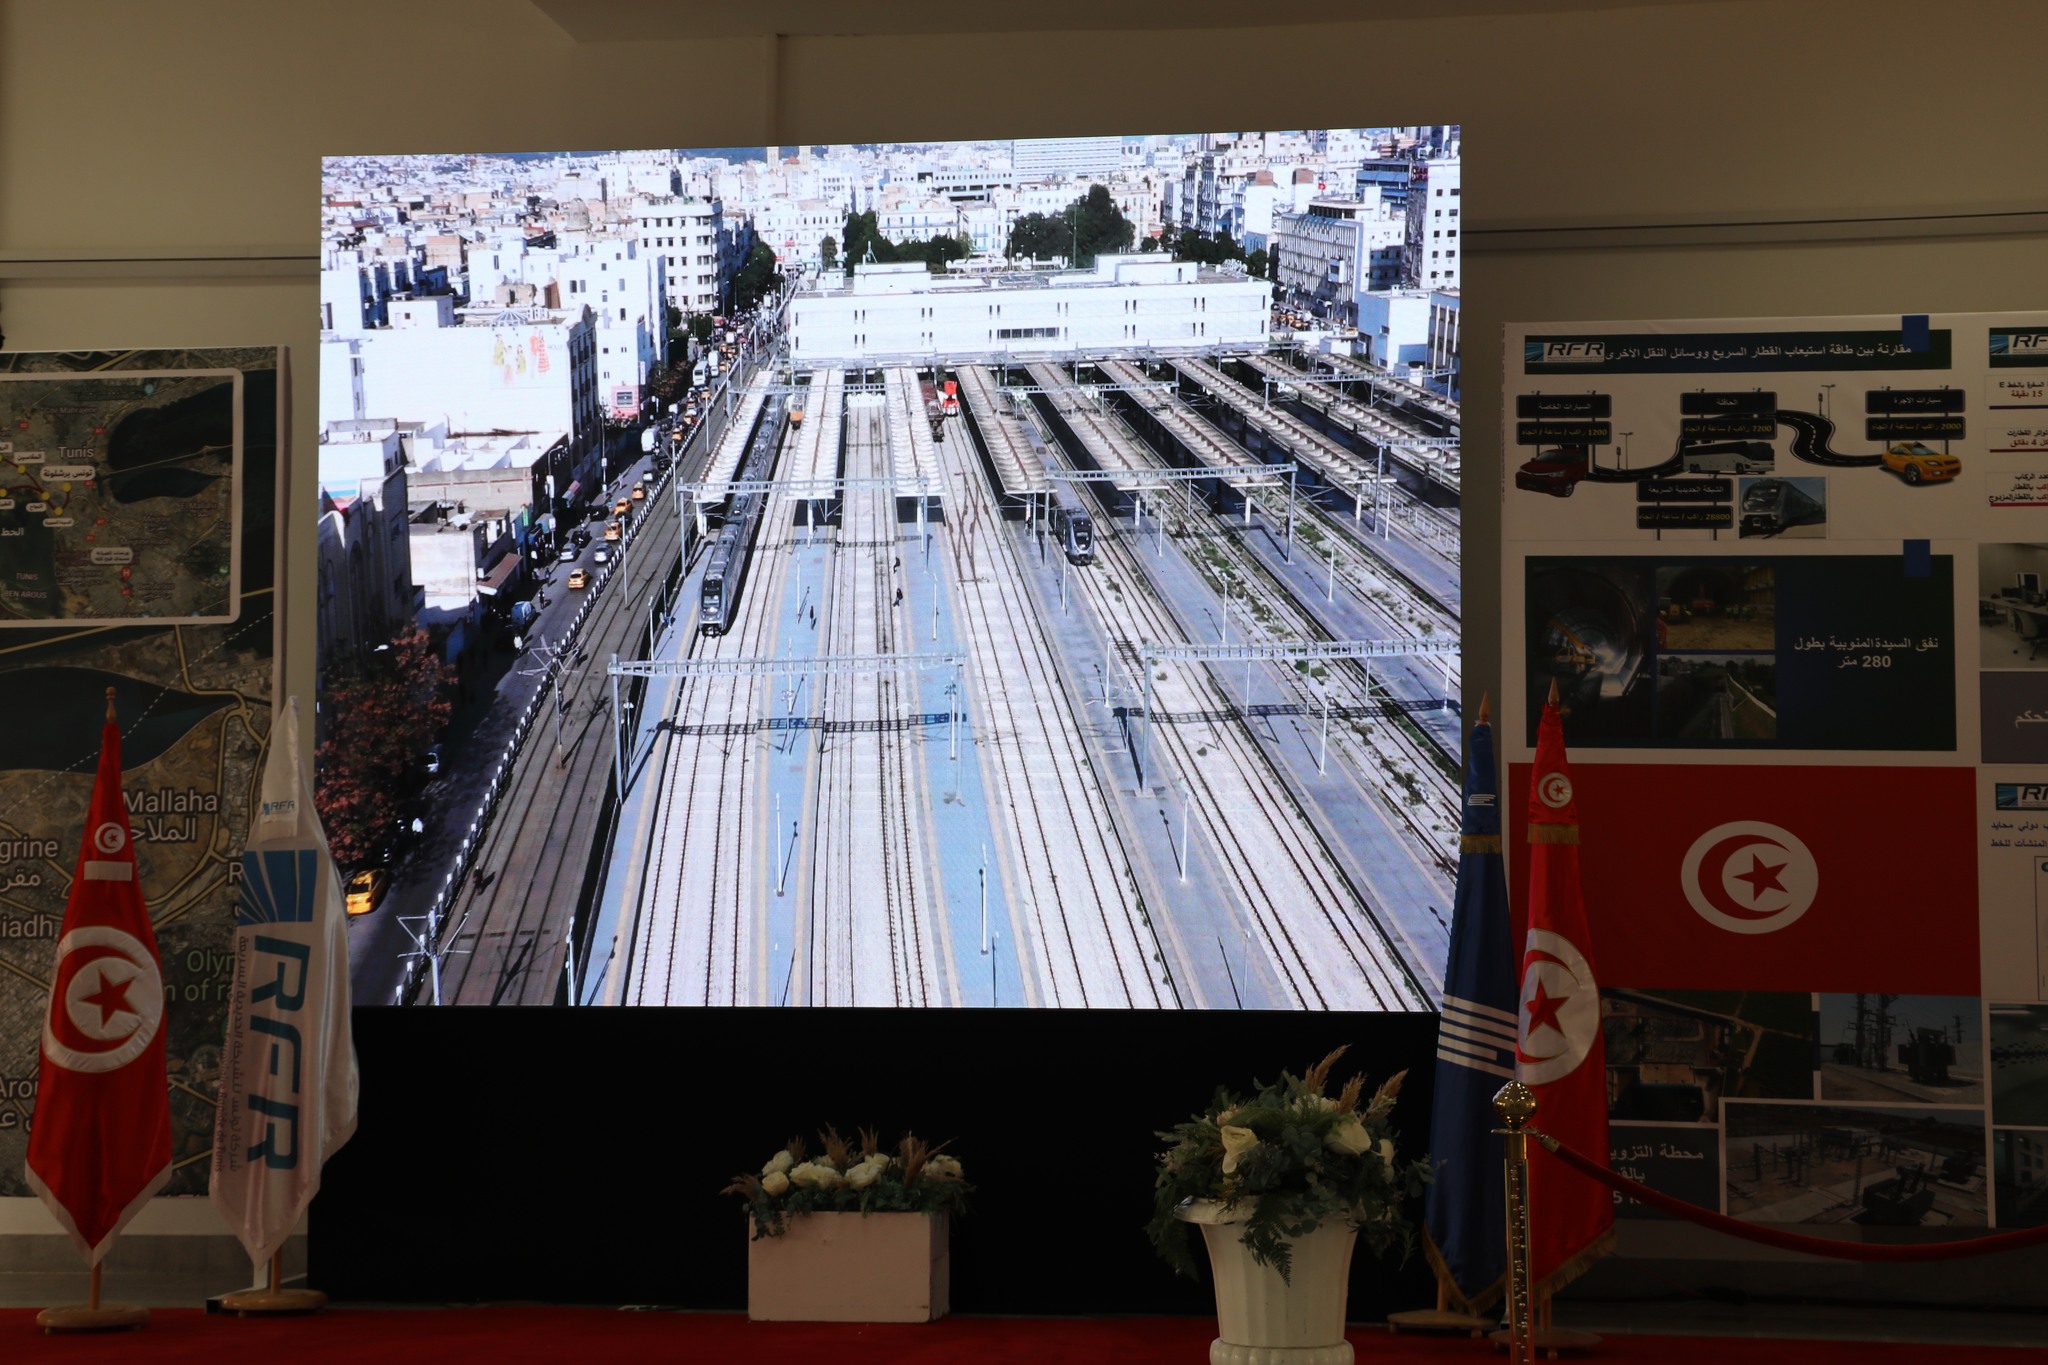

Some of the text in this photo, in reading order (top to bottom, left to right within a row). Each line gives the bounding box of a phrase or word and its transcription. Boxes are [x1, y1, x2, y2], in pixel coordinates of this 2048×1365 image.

[2012, 334, 2048, 348] RF
[1547, 342, 1604, 356] RFR
[1643, 347, 1667, 359] النقل
[1711, 347, 1747, 361] السريع
[1752, 346, 1782, 358] القطار
[1784, 345, 1826, 357] استيعاب
[1829, 344, 1854, 355] طاقة
[1856, 346, 1875, 357] بين
[1877, 343, 1912, 356] مقارنة
[58, 446, 95, 459] Tunis
[16, 572, 39, 581] TUNIS
[1794, 636, 1825, 650] بطول
[1915, 636, 1939, 652] نفق
[1838, 655, 1892, 669] 280 متر
[123, 788, 219, 812] Mallaha
[270, 800, 295, 811] RFR
[129, 817, 197, 842] الملاح
[184, 981, 215, 1001] of
[248, 935, 311, 1170] RFR
[1610, 1143, 1704, 1161] محطة التزوي
